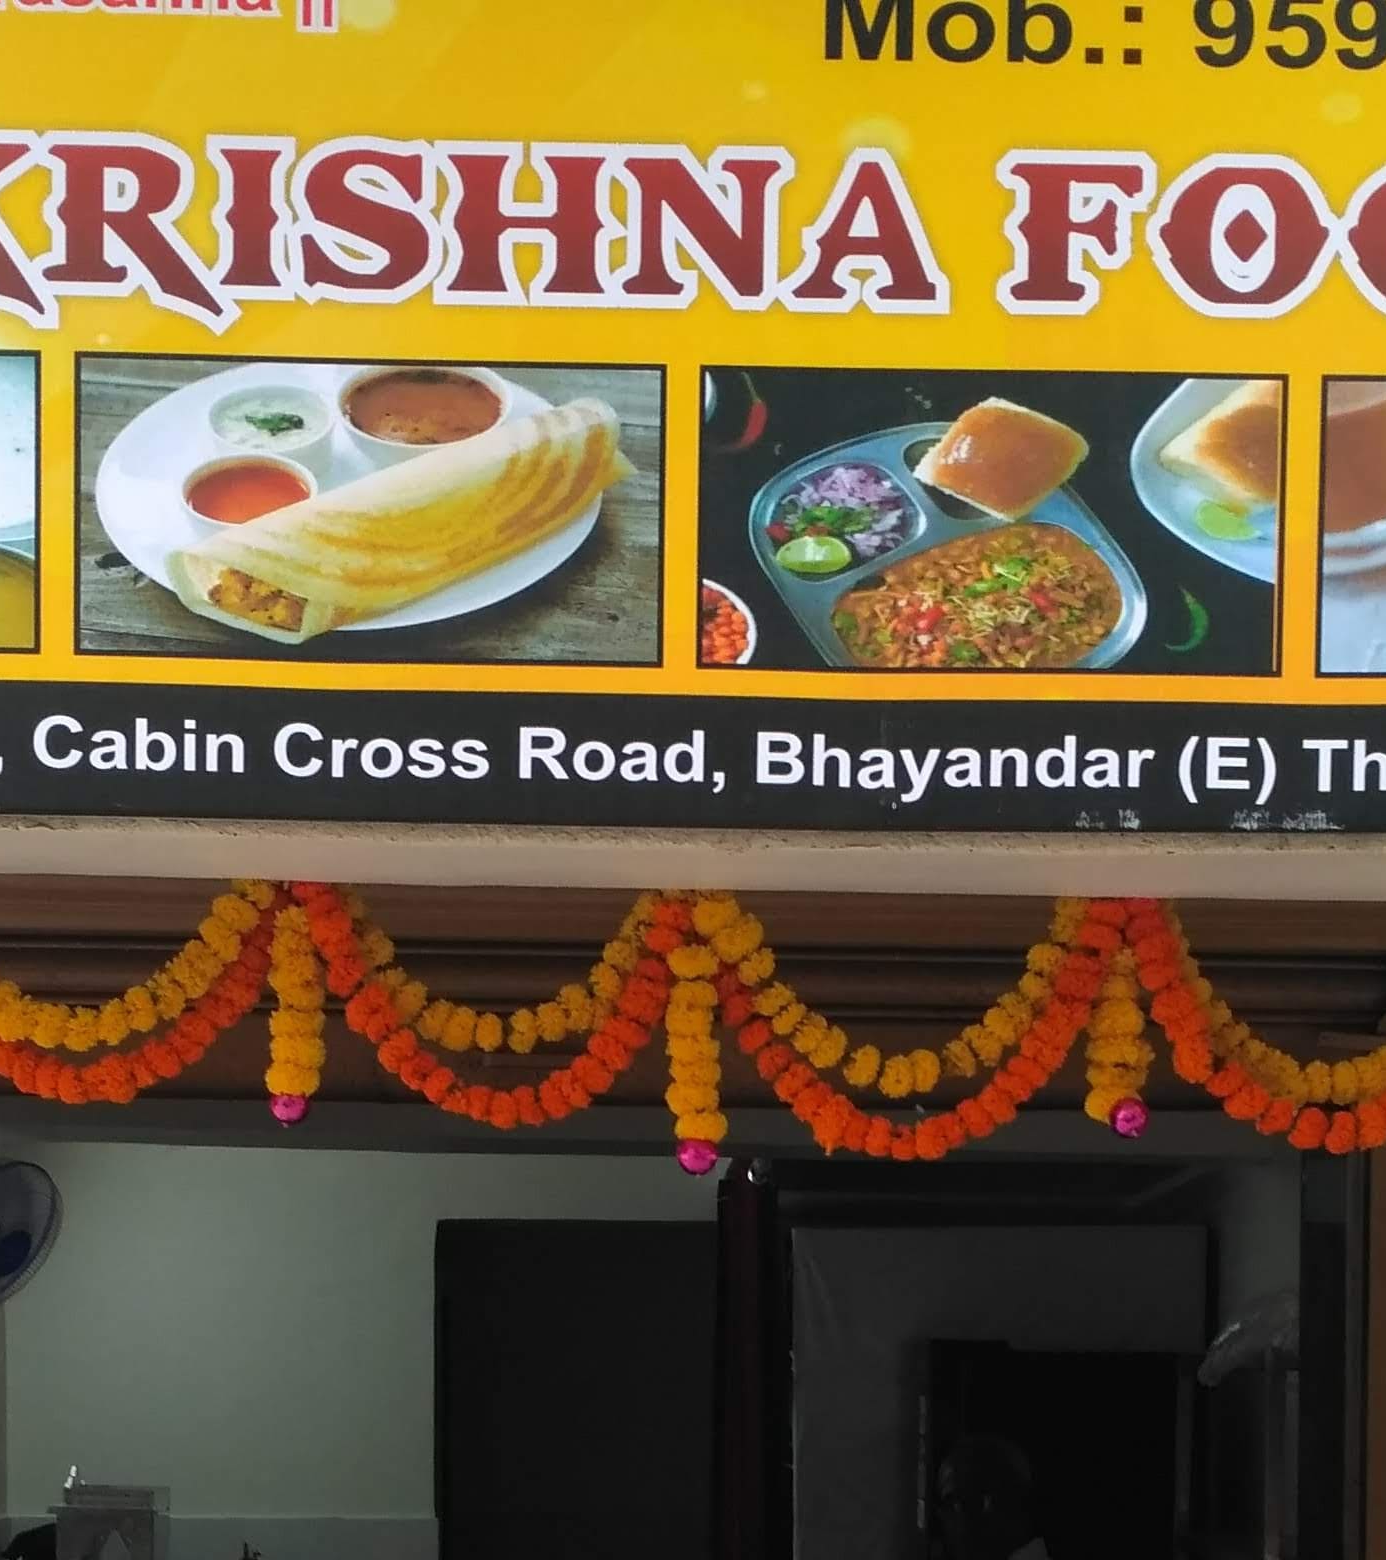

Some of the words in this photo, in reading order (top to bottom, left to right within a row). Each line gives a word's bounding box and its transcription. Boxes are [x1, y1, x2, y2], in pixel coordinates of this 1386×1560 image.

[823, 0, 1144, 65] Mob.:
[32, 714, 245, 773] Cabin
[273, 722, 490, 780] Cross
[518, 726, 726, 794] Road,
[756, 731, 1156, 799] Bhayandar
[1178, 735, 1277, 804] (E)
